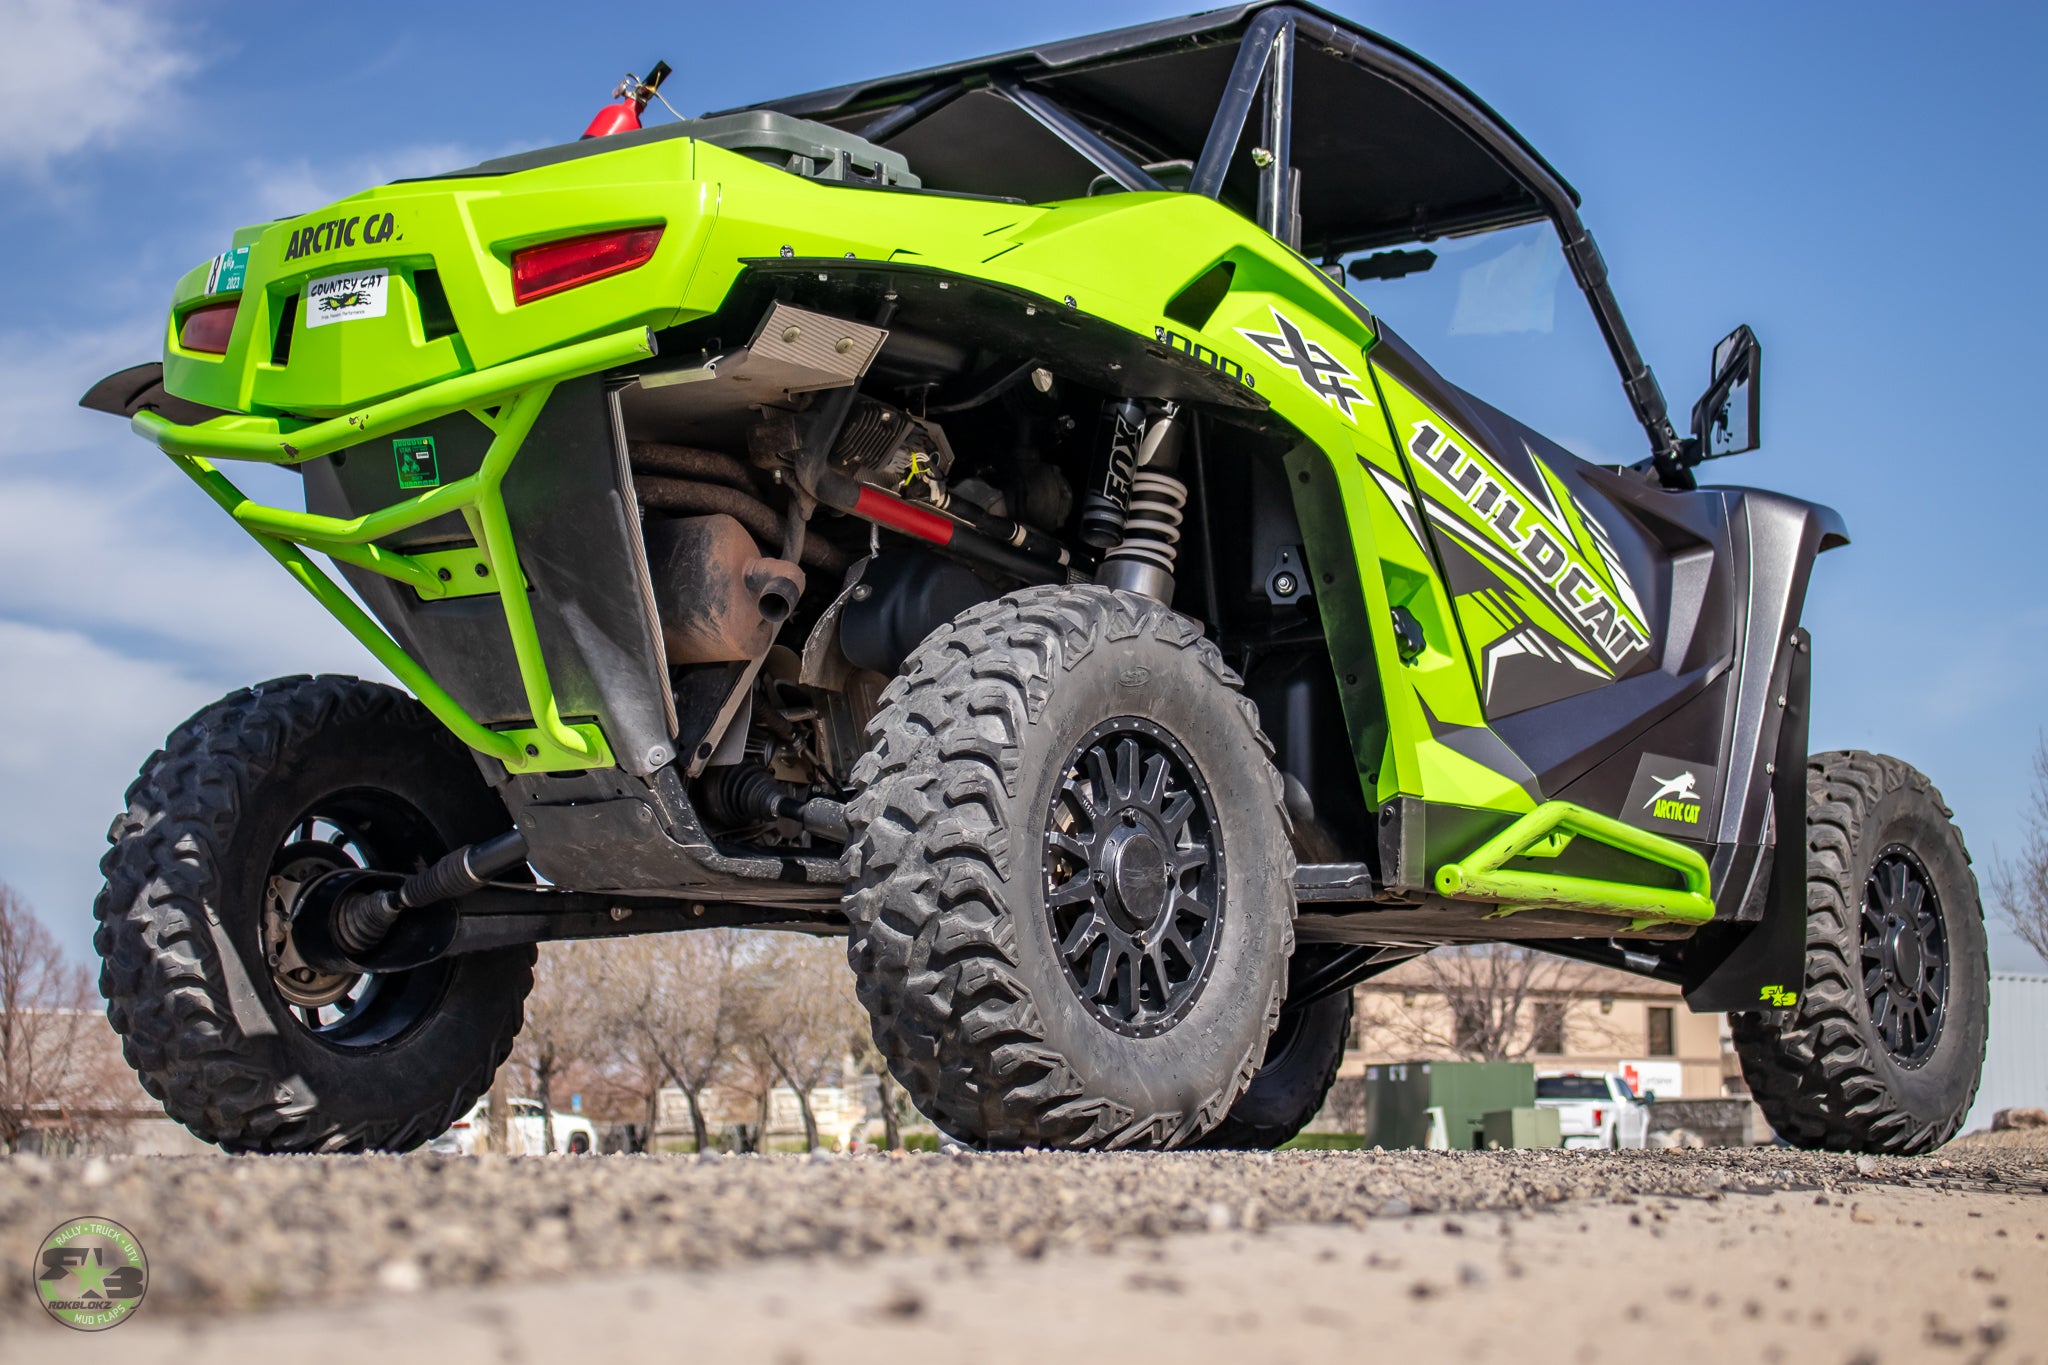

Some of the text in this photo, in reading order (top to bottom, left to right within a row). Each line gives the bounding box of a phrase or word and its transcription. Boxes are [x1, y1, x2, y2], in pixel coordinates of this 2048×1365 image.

[284, 212, 404, 262] ARCTIC CA
[310, 274, 383, 297] COUNTRY CAT
[1103, 413, 1138, 512] FOX
[1408, 419, 1650, 664] WILDCAT
[1653, 799, 1701, 824] ARCTIC CAT
